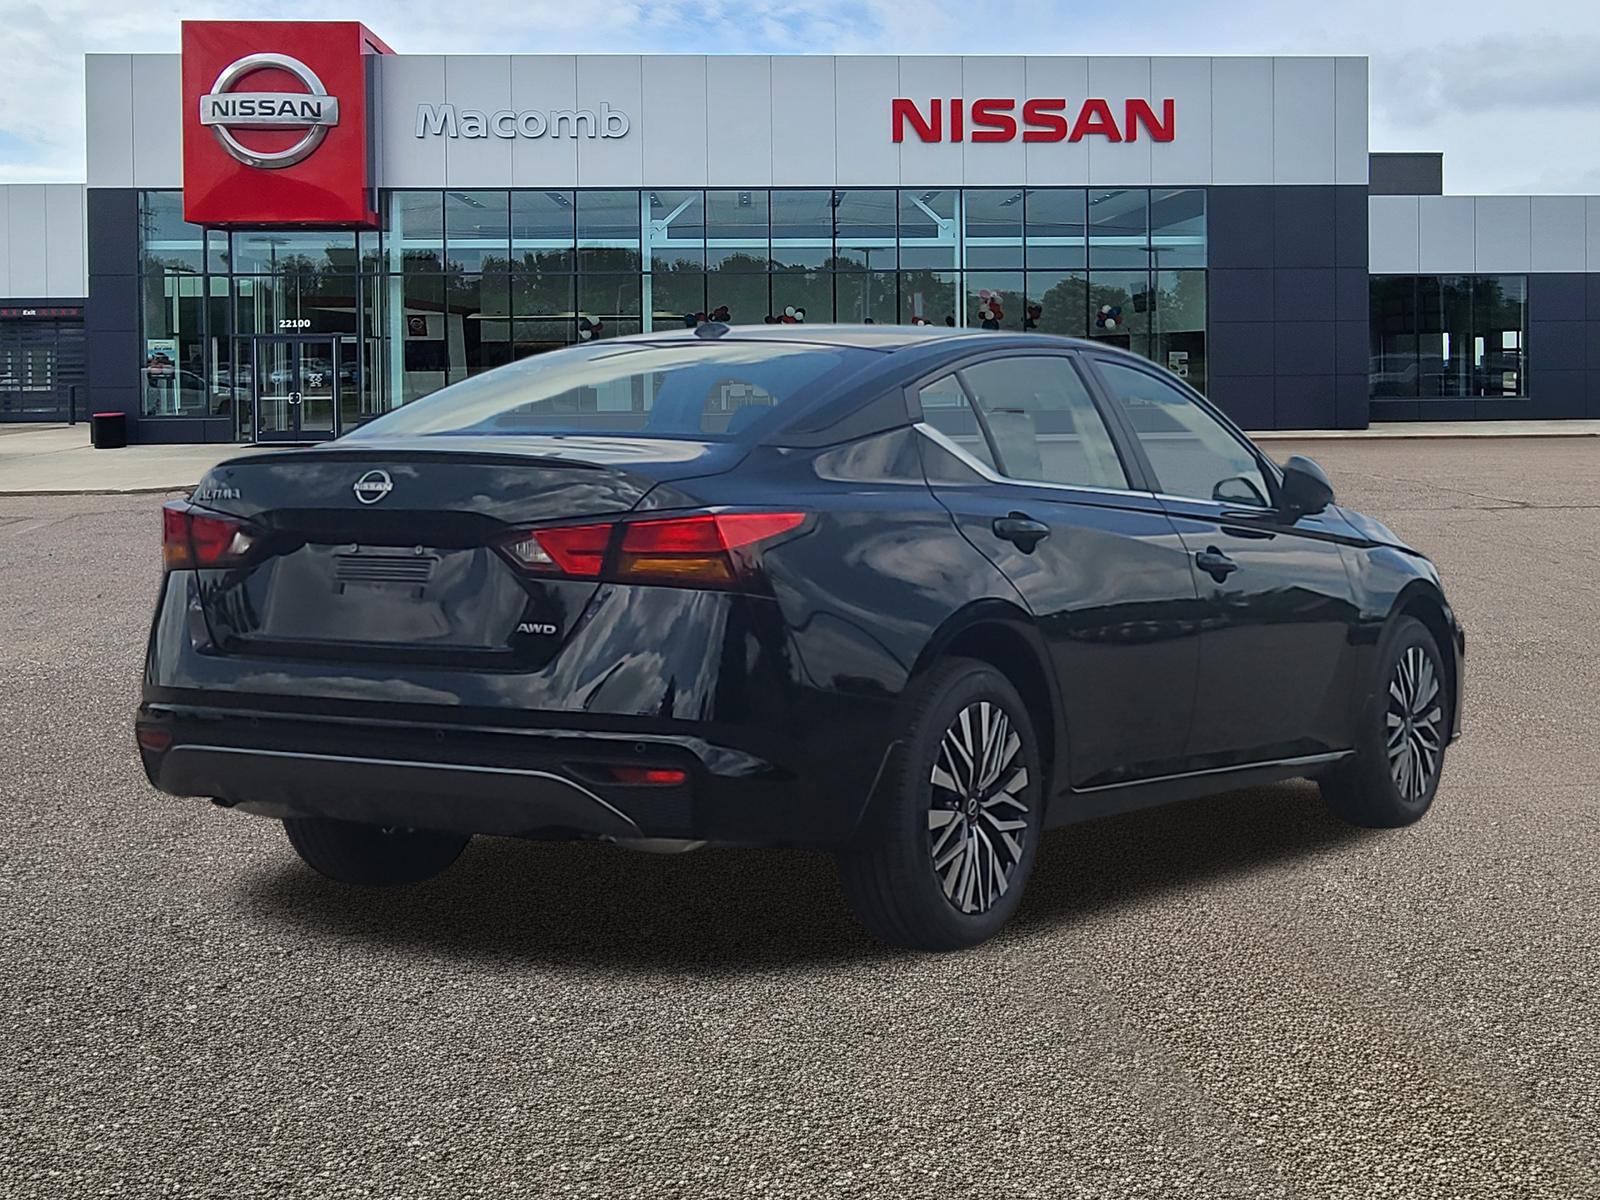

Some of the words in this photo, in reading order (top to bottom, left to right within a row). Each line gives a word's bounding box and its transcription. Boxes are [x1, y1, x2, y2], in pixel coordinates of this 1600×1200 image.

[212, 100, 321, 117] NISSAN
[415, 102, 629, 138] Macomb
[892, 98, 1175, 143] NISSAN
[279, 319, 311, 328] 22100
[516, 623, 557, 634] AWD
